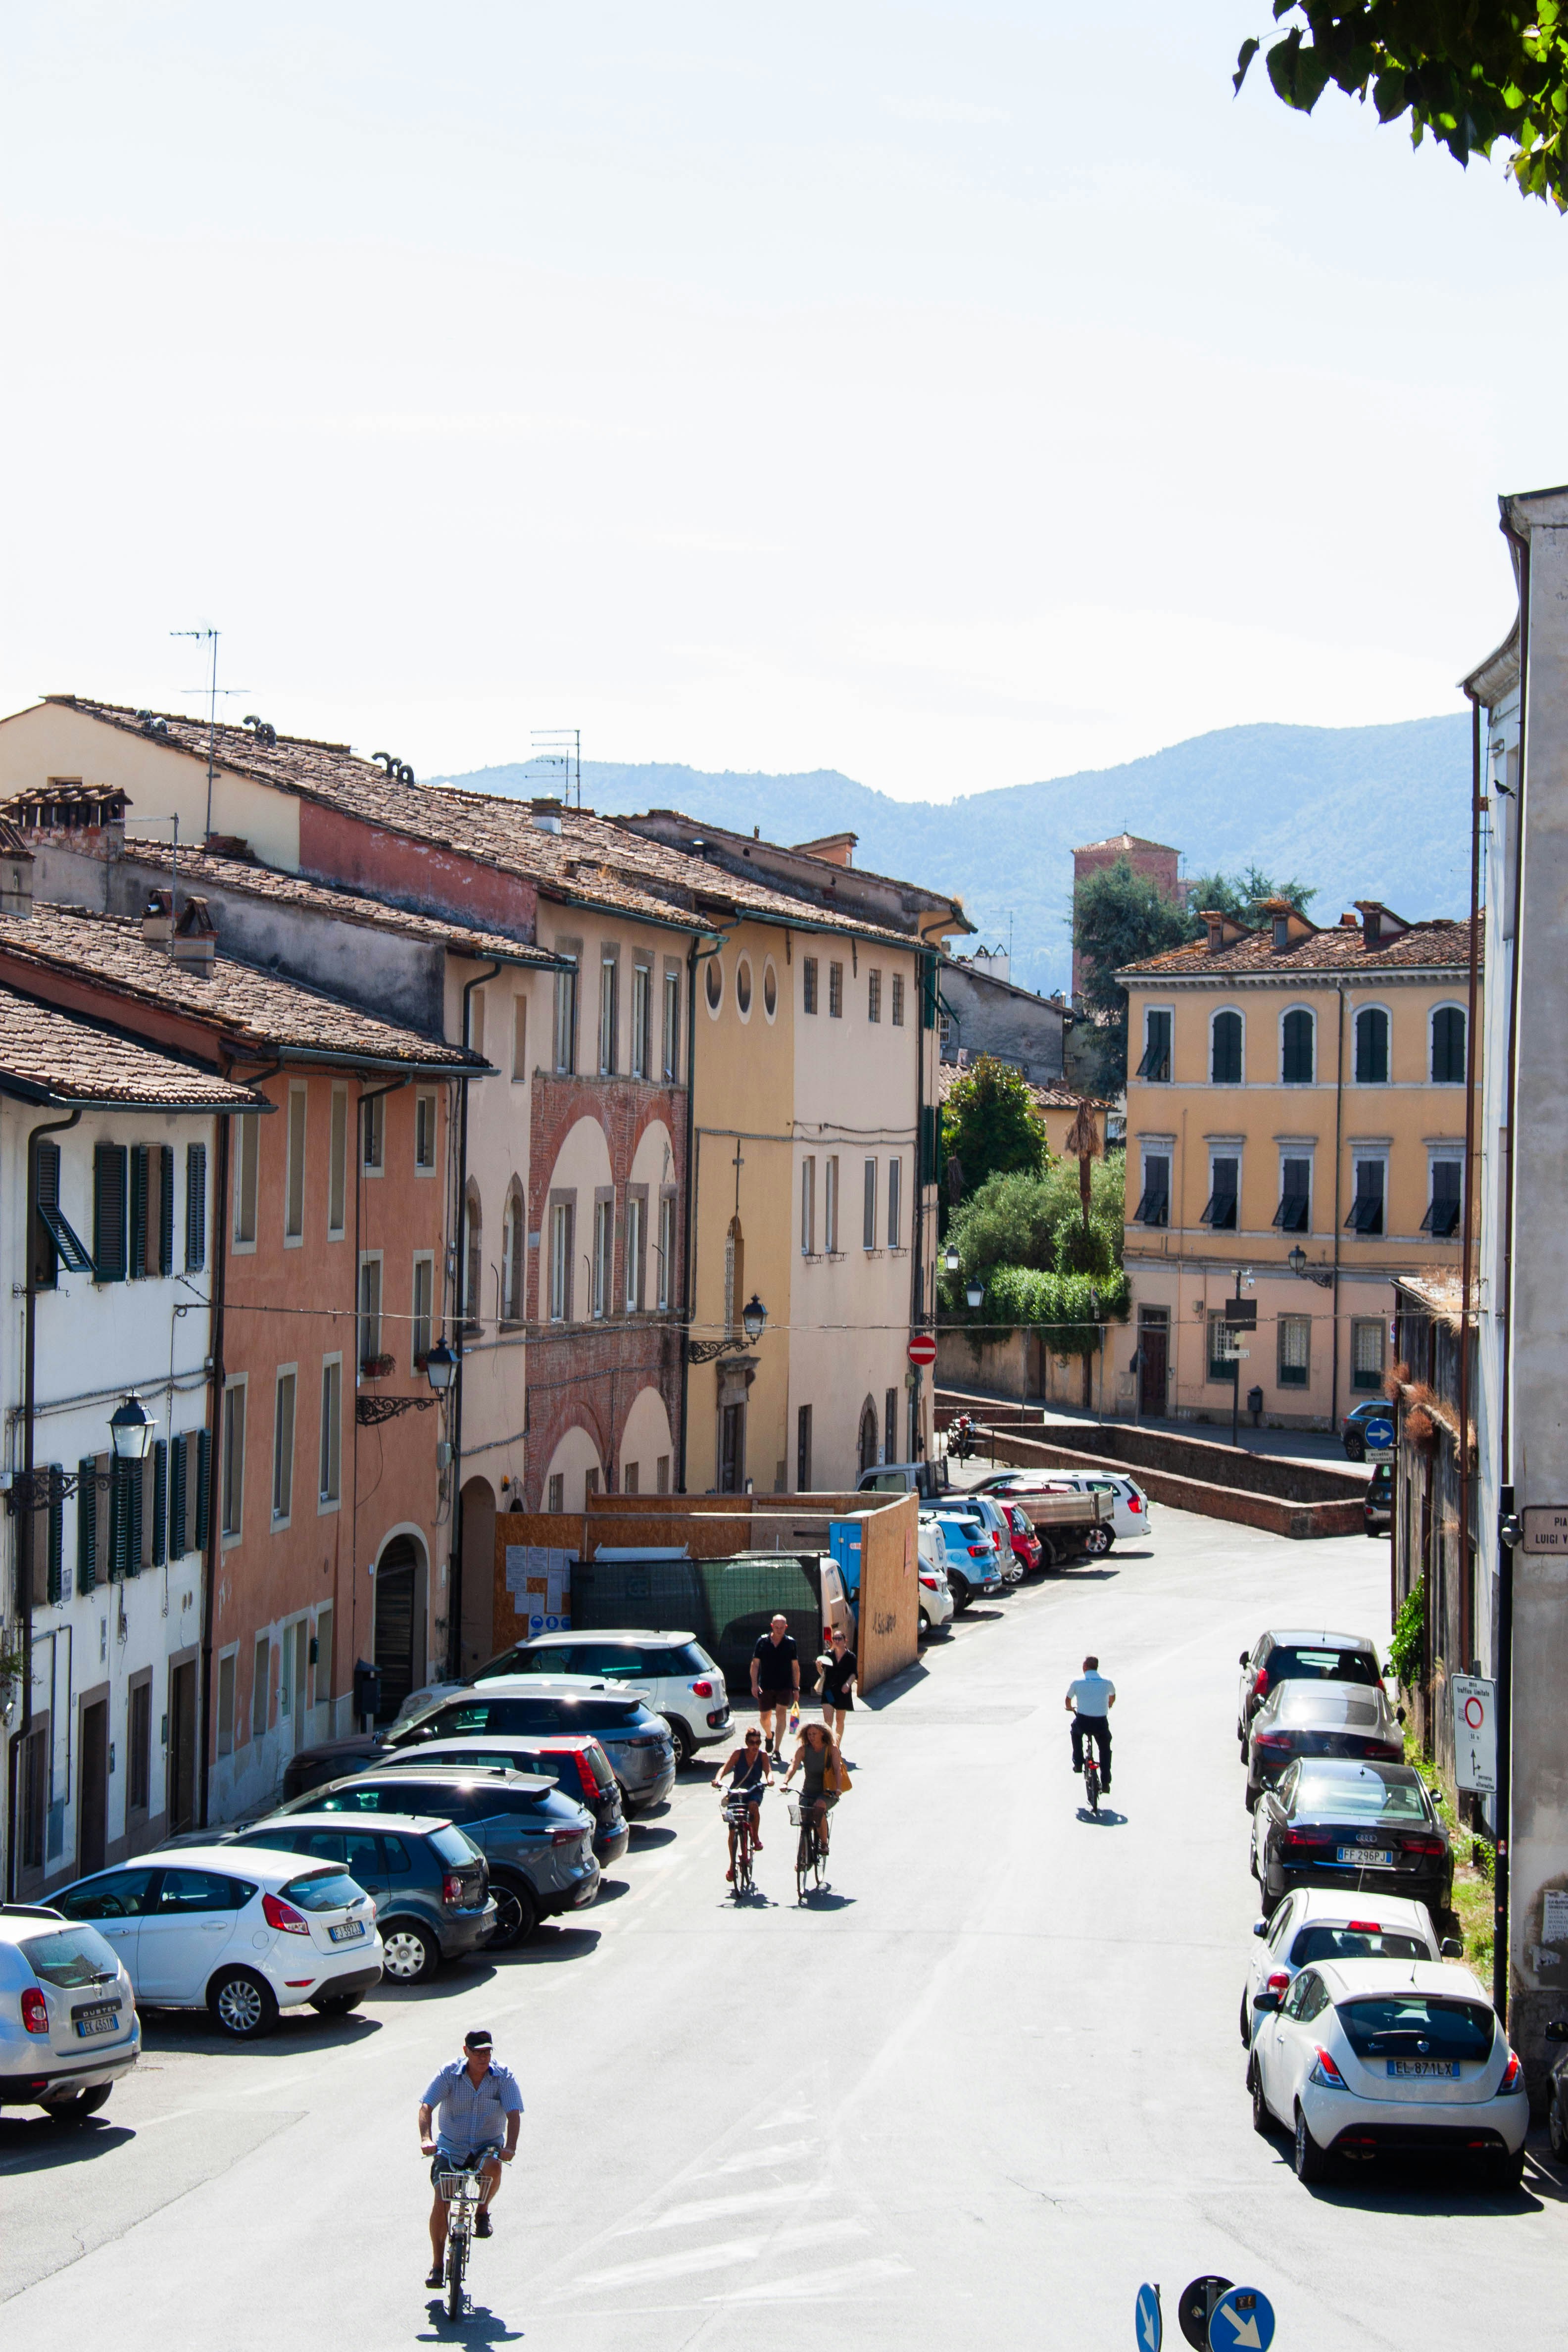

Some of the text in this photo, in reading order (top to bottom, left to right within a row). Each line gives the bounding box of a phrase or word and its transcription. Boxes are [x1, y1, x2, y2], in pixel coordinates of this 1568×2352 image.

[1555, 1517, 1568, 1526] PIA
[1536, 1534, 1558, 1544] LUIGI
[1457, 1686, 1489, 1697] traffico limitato
[1344, 1850, 1385, 1862] FF 296PJ
[334, 1923, 361, 1938] FJ 392JJ
[83, 2006, 116, 2017] DUSTER
[84, 2020, 94, 2034] EK
[1396, 2061, 1452, 2075] EL 871LX
